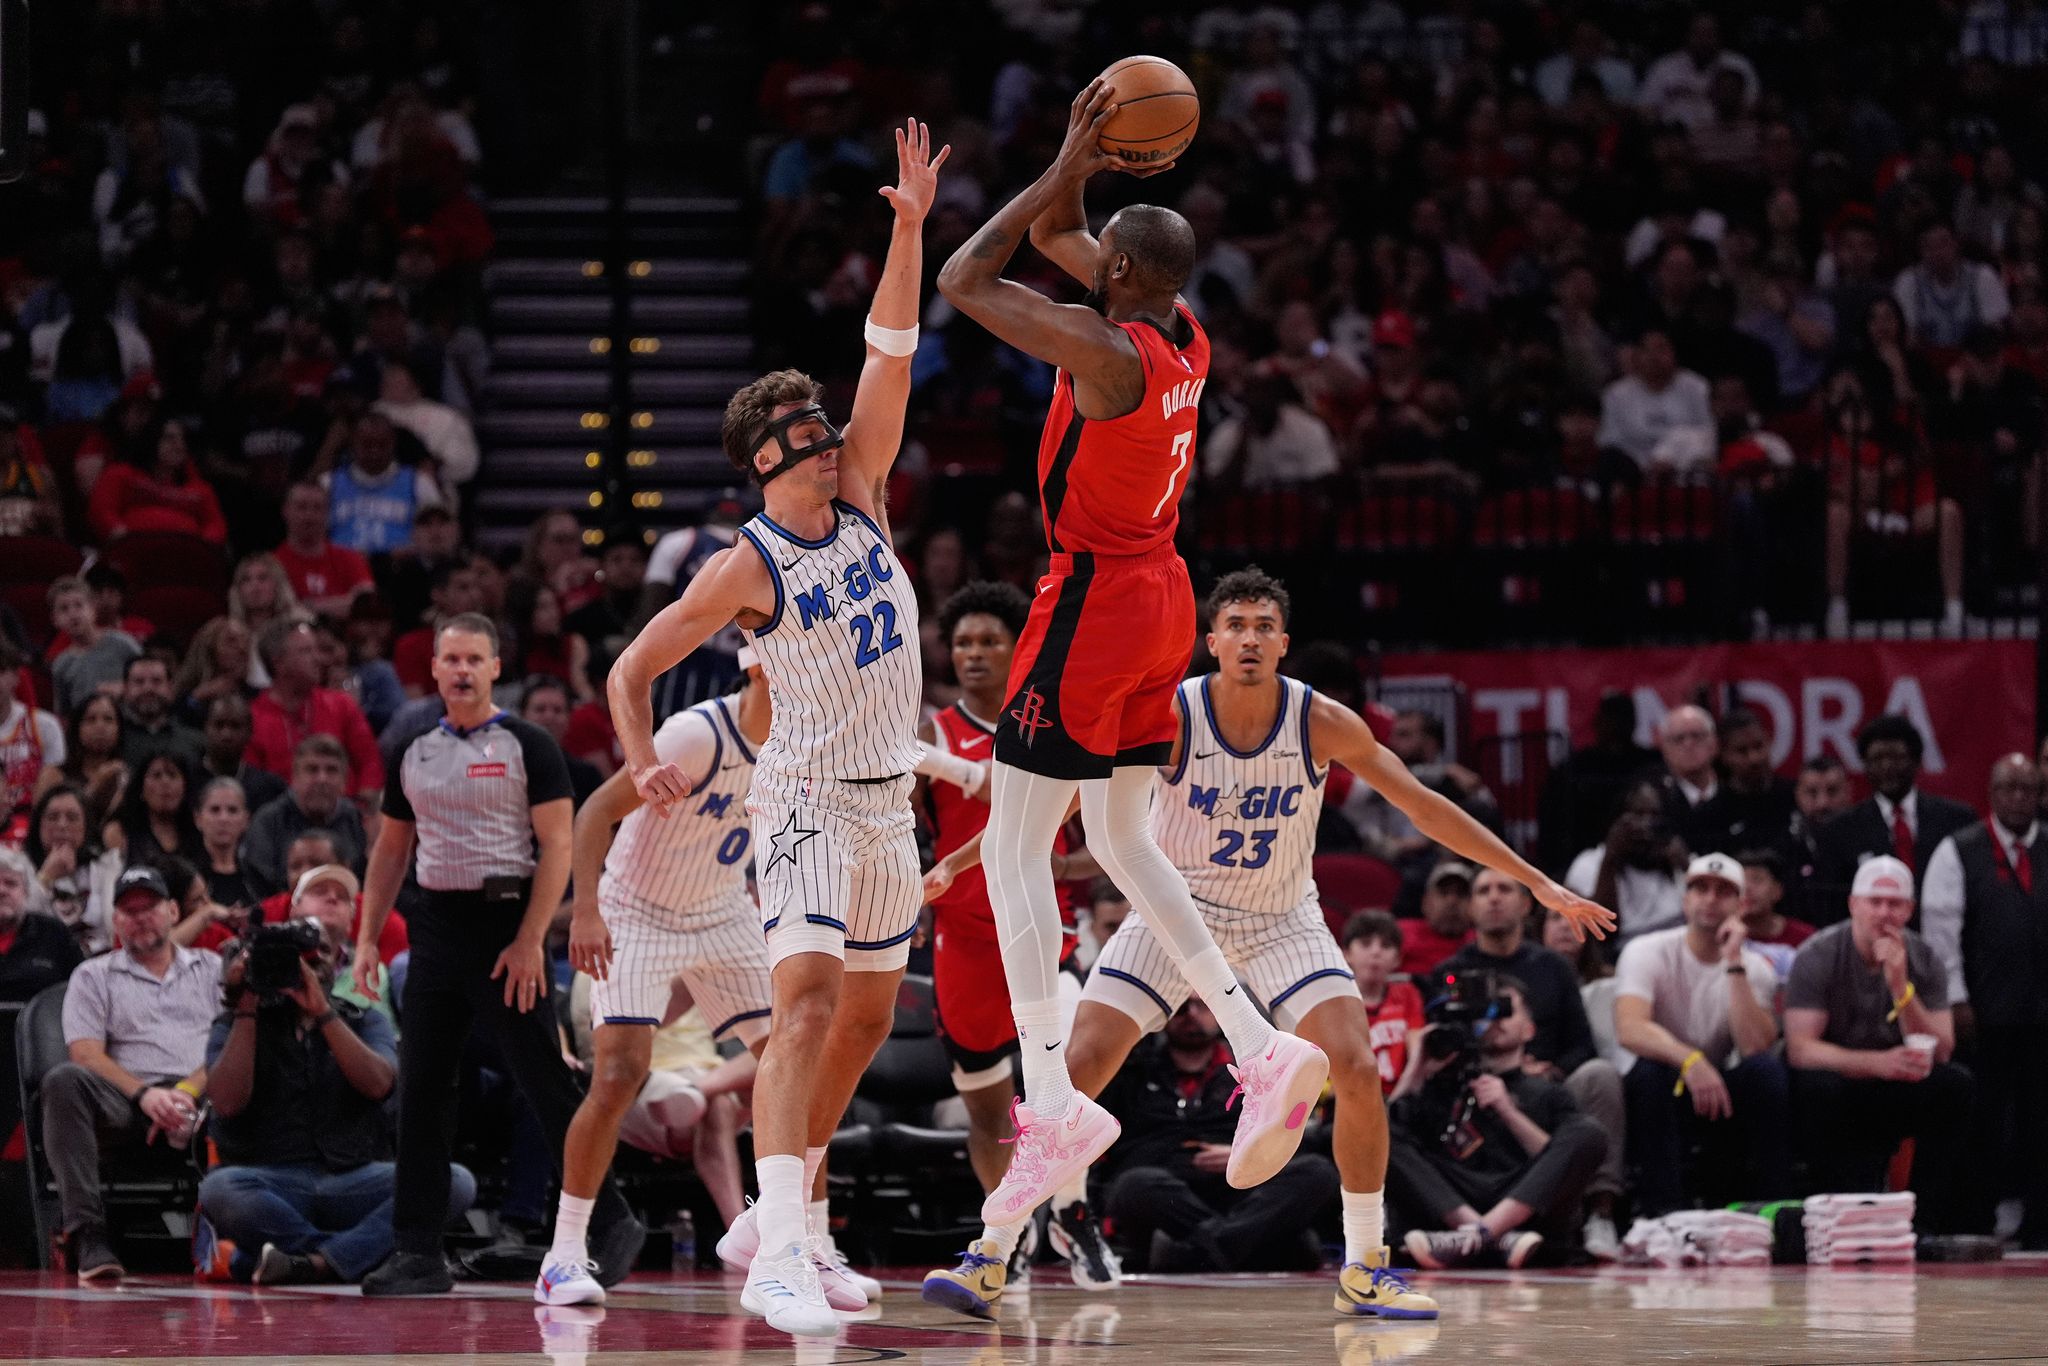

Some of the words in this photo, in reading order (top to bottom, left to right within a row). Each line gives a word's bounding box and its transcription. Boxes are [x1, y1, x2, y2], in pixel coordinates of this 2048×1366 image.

[1152, 429, 1193, 519] 7
[850, 600, 904, 670] 22
[1188, 783, 1304, 820] MAGIC
[717, 826, 750, 865] 0
[1209, 829, 1278, 869] 23
